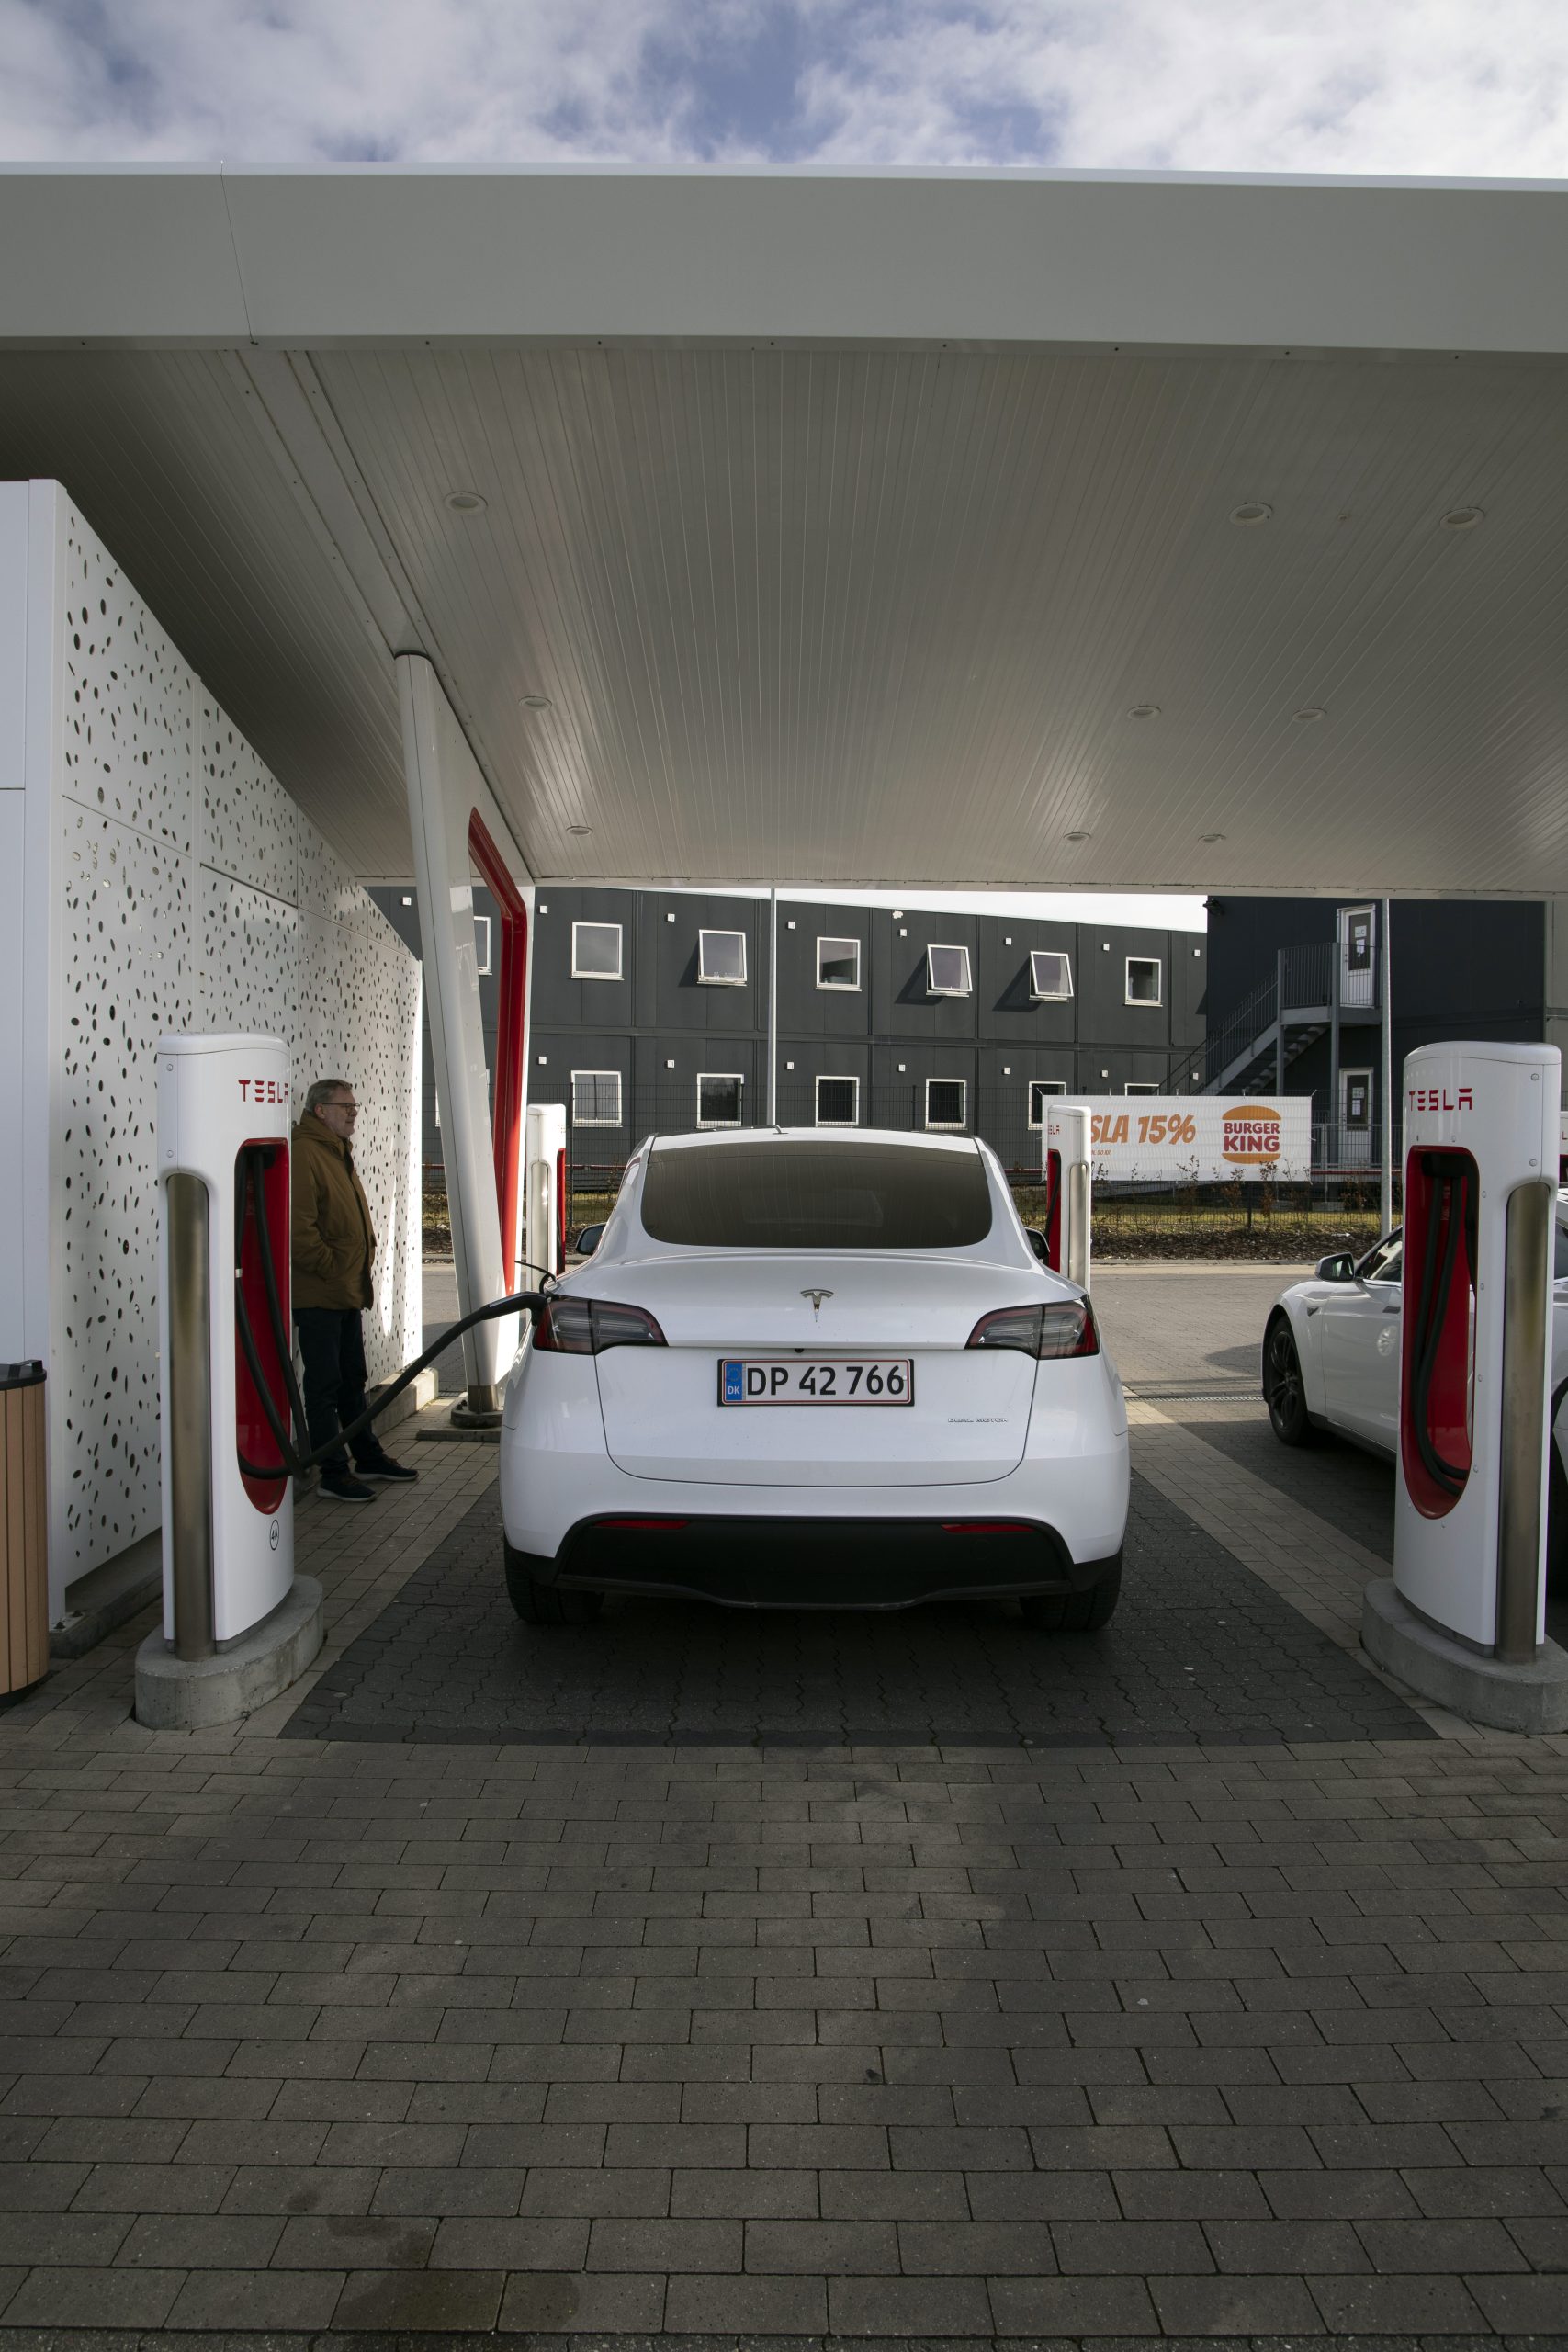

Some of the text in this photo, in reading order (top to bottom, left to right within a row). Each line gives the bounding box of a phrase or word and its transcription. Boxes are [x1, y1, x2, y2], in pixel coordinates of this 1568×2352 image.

[1409, 1088, 1472, 1111] TESLA
[1091, 1114, 1196, 1145] SLA 15%
[1224, 1123, 1280, 1134] BURGER
[1224, 1135, 1280, 1152] KING
[728, 1385, 740, 1395] DK
[747, 1365, 905, 1396] DP 42 766
